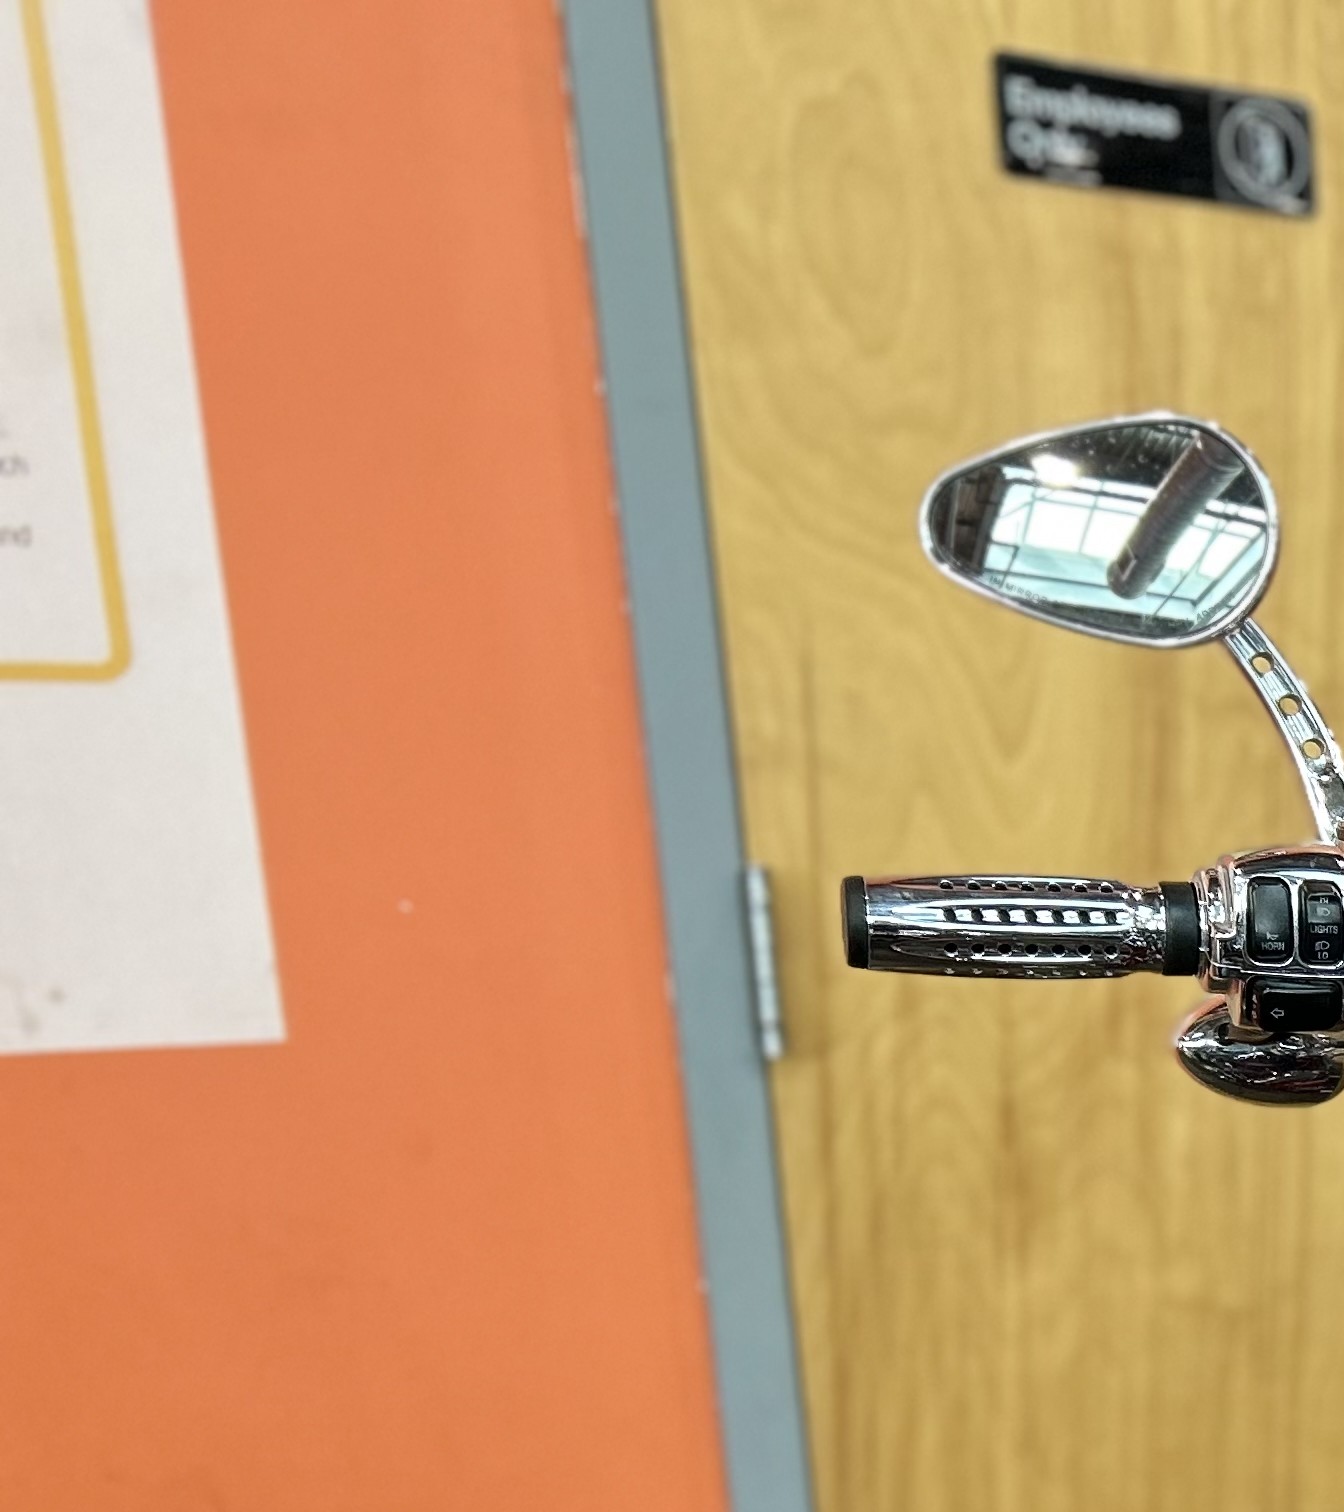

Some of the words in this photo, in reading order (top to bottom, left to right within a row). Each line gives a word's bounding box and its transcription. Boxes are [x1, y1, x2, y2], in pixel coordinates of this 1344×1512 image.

[1004, 74, 1182, 141] Employees
[1006, 119, 1100, 168] Only
[1310, 925, 1338, 934] LIGHTS
[1261, 942, 1285, 951] HORN
